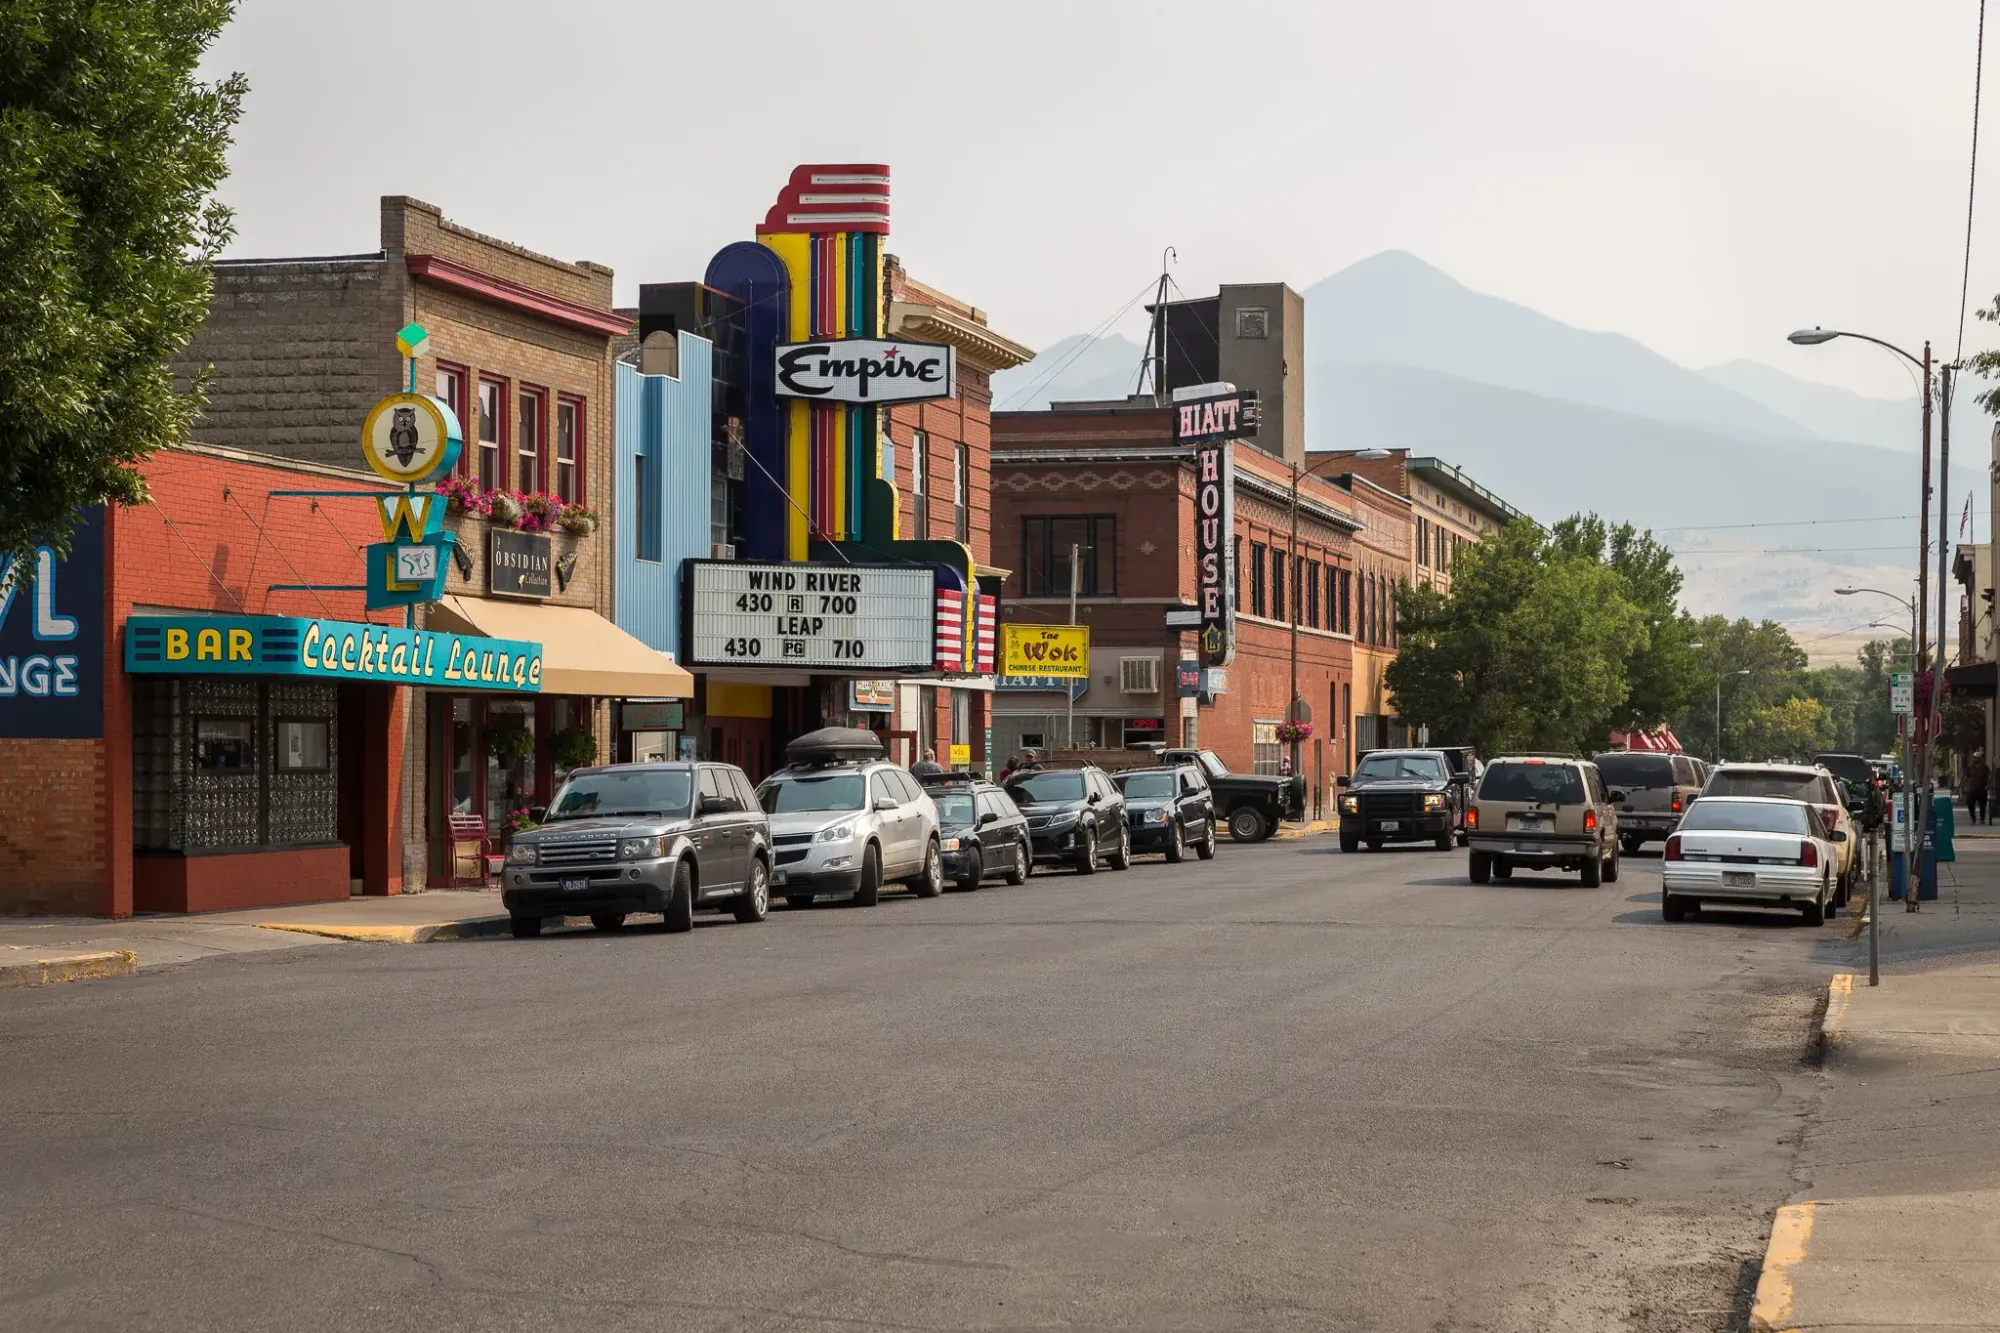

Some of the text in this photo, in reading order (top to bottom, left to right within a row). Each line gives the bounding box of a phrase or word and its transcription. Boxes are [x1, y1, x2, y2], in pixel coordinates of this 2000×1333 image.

[777, 346, 944, 398] Empire
[1179, 399, 1240, 437] HIATT
[1201, 450, 1220, 618] HOUSE
[496, 551, 548, 571] OBSIDIAN
[749, 571, 861, 592] WIND RIVER
[736, 594, 857, 614] 430 R 700
[777, 617, 823, 636] LEAP
[166, 628, 253, 661] BAR
[302, 621, 541, 688] Cocktail Lounge
[724, 638, 864, 659] 430 PG 710
[1023, 641, 1079, 661] Wok
[1008, 664, 1082, 673] CHINESE RESTAURANT
[1133, 719, 1158, 729] OPEN
